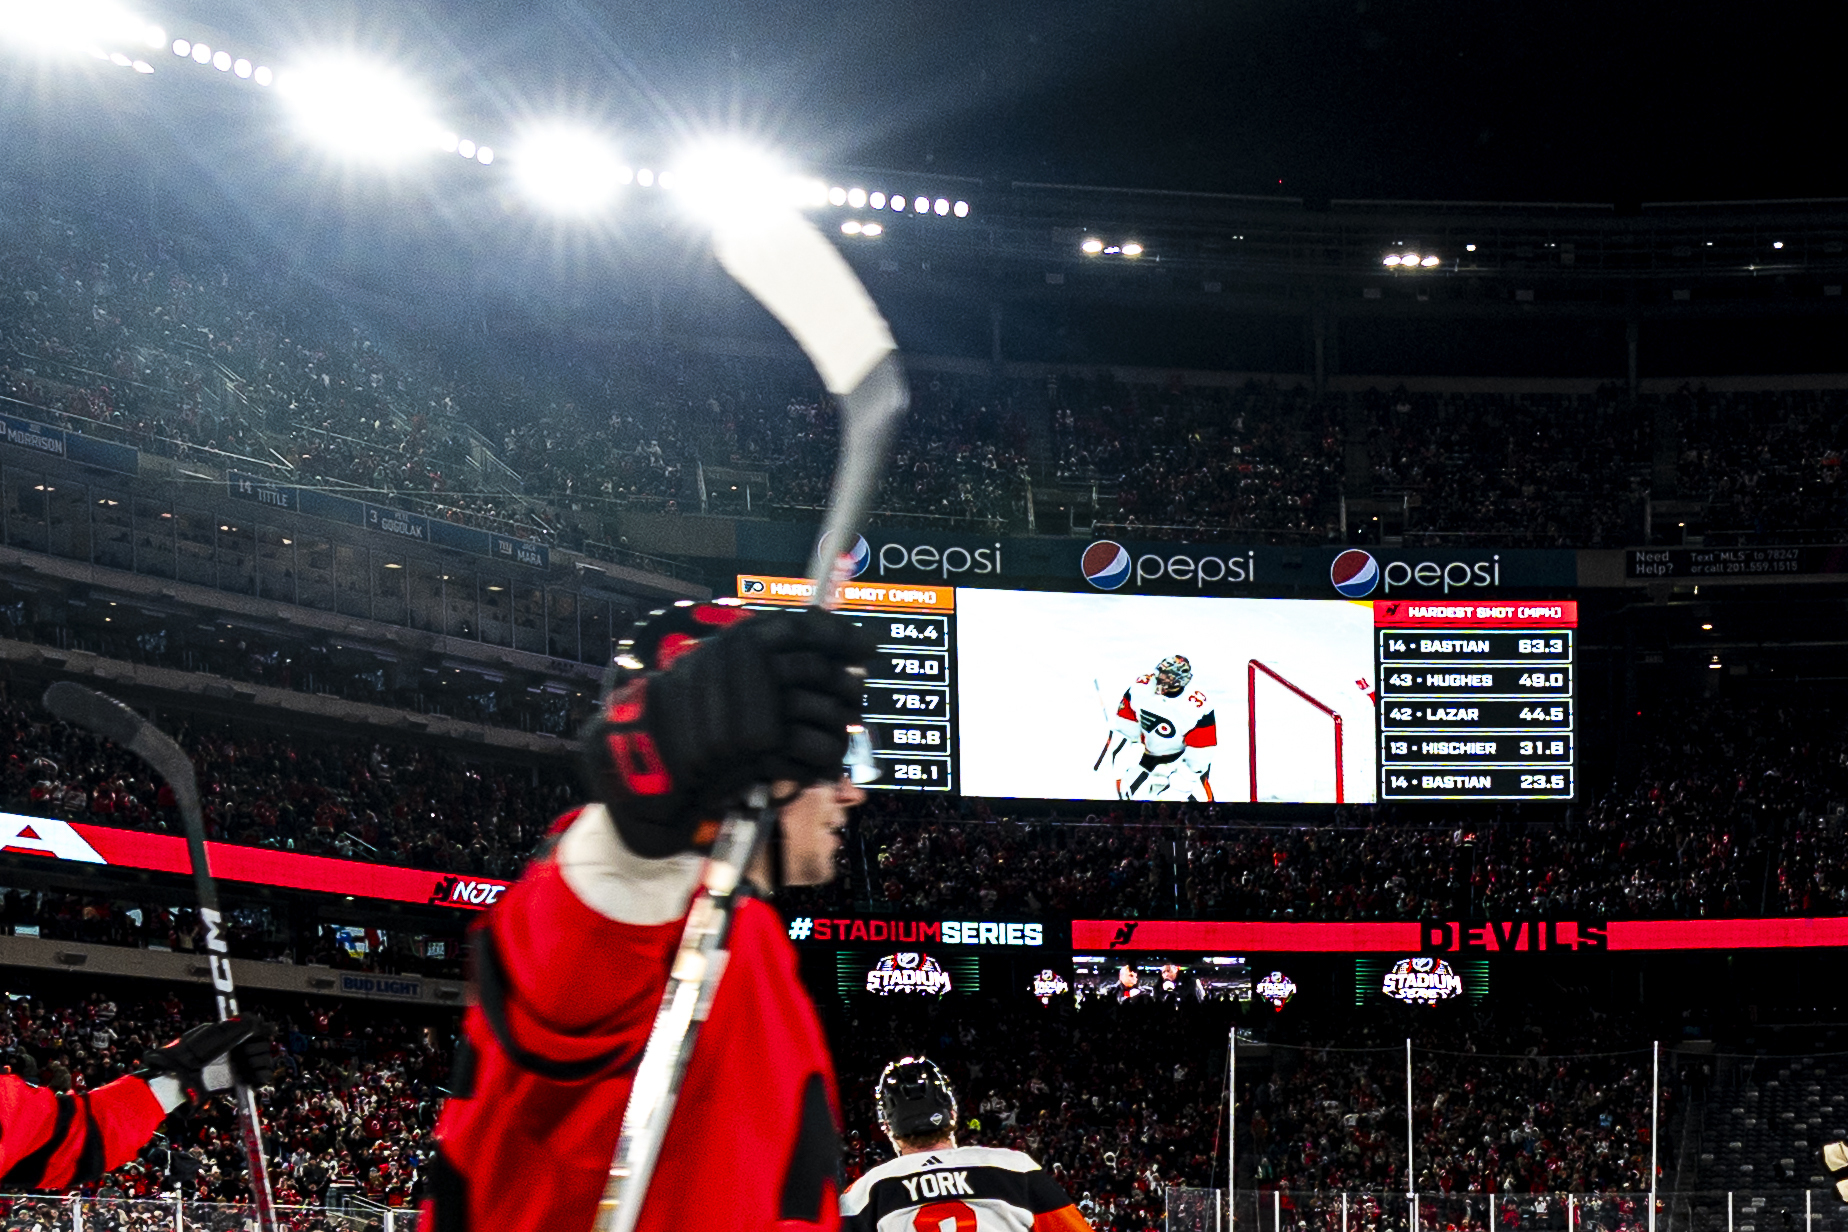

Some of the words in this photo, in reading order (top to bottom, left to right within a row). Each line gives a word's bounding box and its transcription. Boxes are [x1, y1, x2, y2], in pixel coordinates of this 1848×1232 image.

[7, 428, 63, 454] MORRISON
[257, 488, 288, 507] TITTLE
[517, 550, 543, 566] MARA
[880, 543, 1001, 579] pepsi
[1636, 551, 1669, 562] Need
[1691, 552, 1713, 562] Text
[1754, 550, 1764, 560] to
[1137, 550, 1254, 587] pepsi
[1384, 554, 1499, 594] pepsi
[1636, 563, 1674, 575] Help?
[1704, 563, 1724, 573] call
[771, 583, 841, 599] HARD
[845, 588, 886, 601] SHOT
[1408, 606, 1474, 618] HARDEST
[1476, 606, 1515, 618] SHOT
[891, 624, 938, 639] 84.4
[1389, 640, 1406, 652] 14
[1421, 640, 1490, 653] BASTIAN
[892, 659, 938, 674] 78.0
[1389, 674, 1412, 687] 43
[1427, 674, 1493, 687] HUGHES
[1518, 673, 1564, 687] 49.0
[1390, 708, 1413, 721] 42
[1427, 708, 1479, 721] LAZAR
[1519, 707, 1564, 721] 44.5
[1390, 742, 1408, 755] 13
[1422, 742, 1497, 755] HISCHIER
[894, 764, 938, 779] 26.1
[1390, 776, 1408, 788] 14
[1422, 776, 1491, 789] BASTIAN
[1520, 775, 1565, 789] 23.5
[789, 917, 1043, 946] #STADIUMSERIES
[1420, 921, 1609, 952] DEVILS
[343, 976, 377, 993] BUD
[382, 979, 420, 996] LIGHT
[866, 969, 951, 993] STADIUM
[1383, 973, 1462, 994] STADIUM
[902, 1171, 974, 1201] YORK
